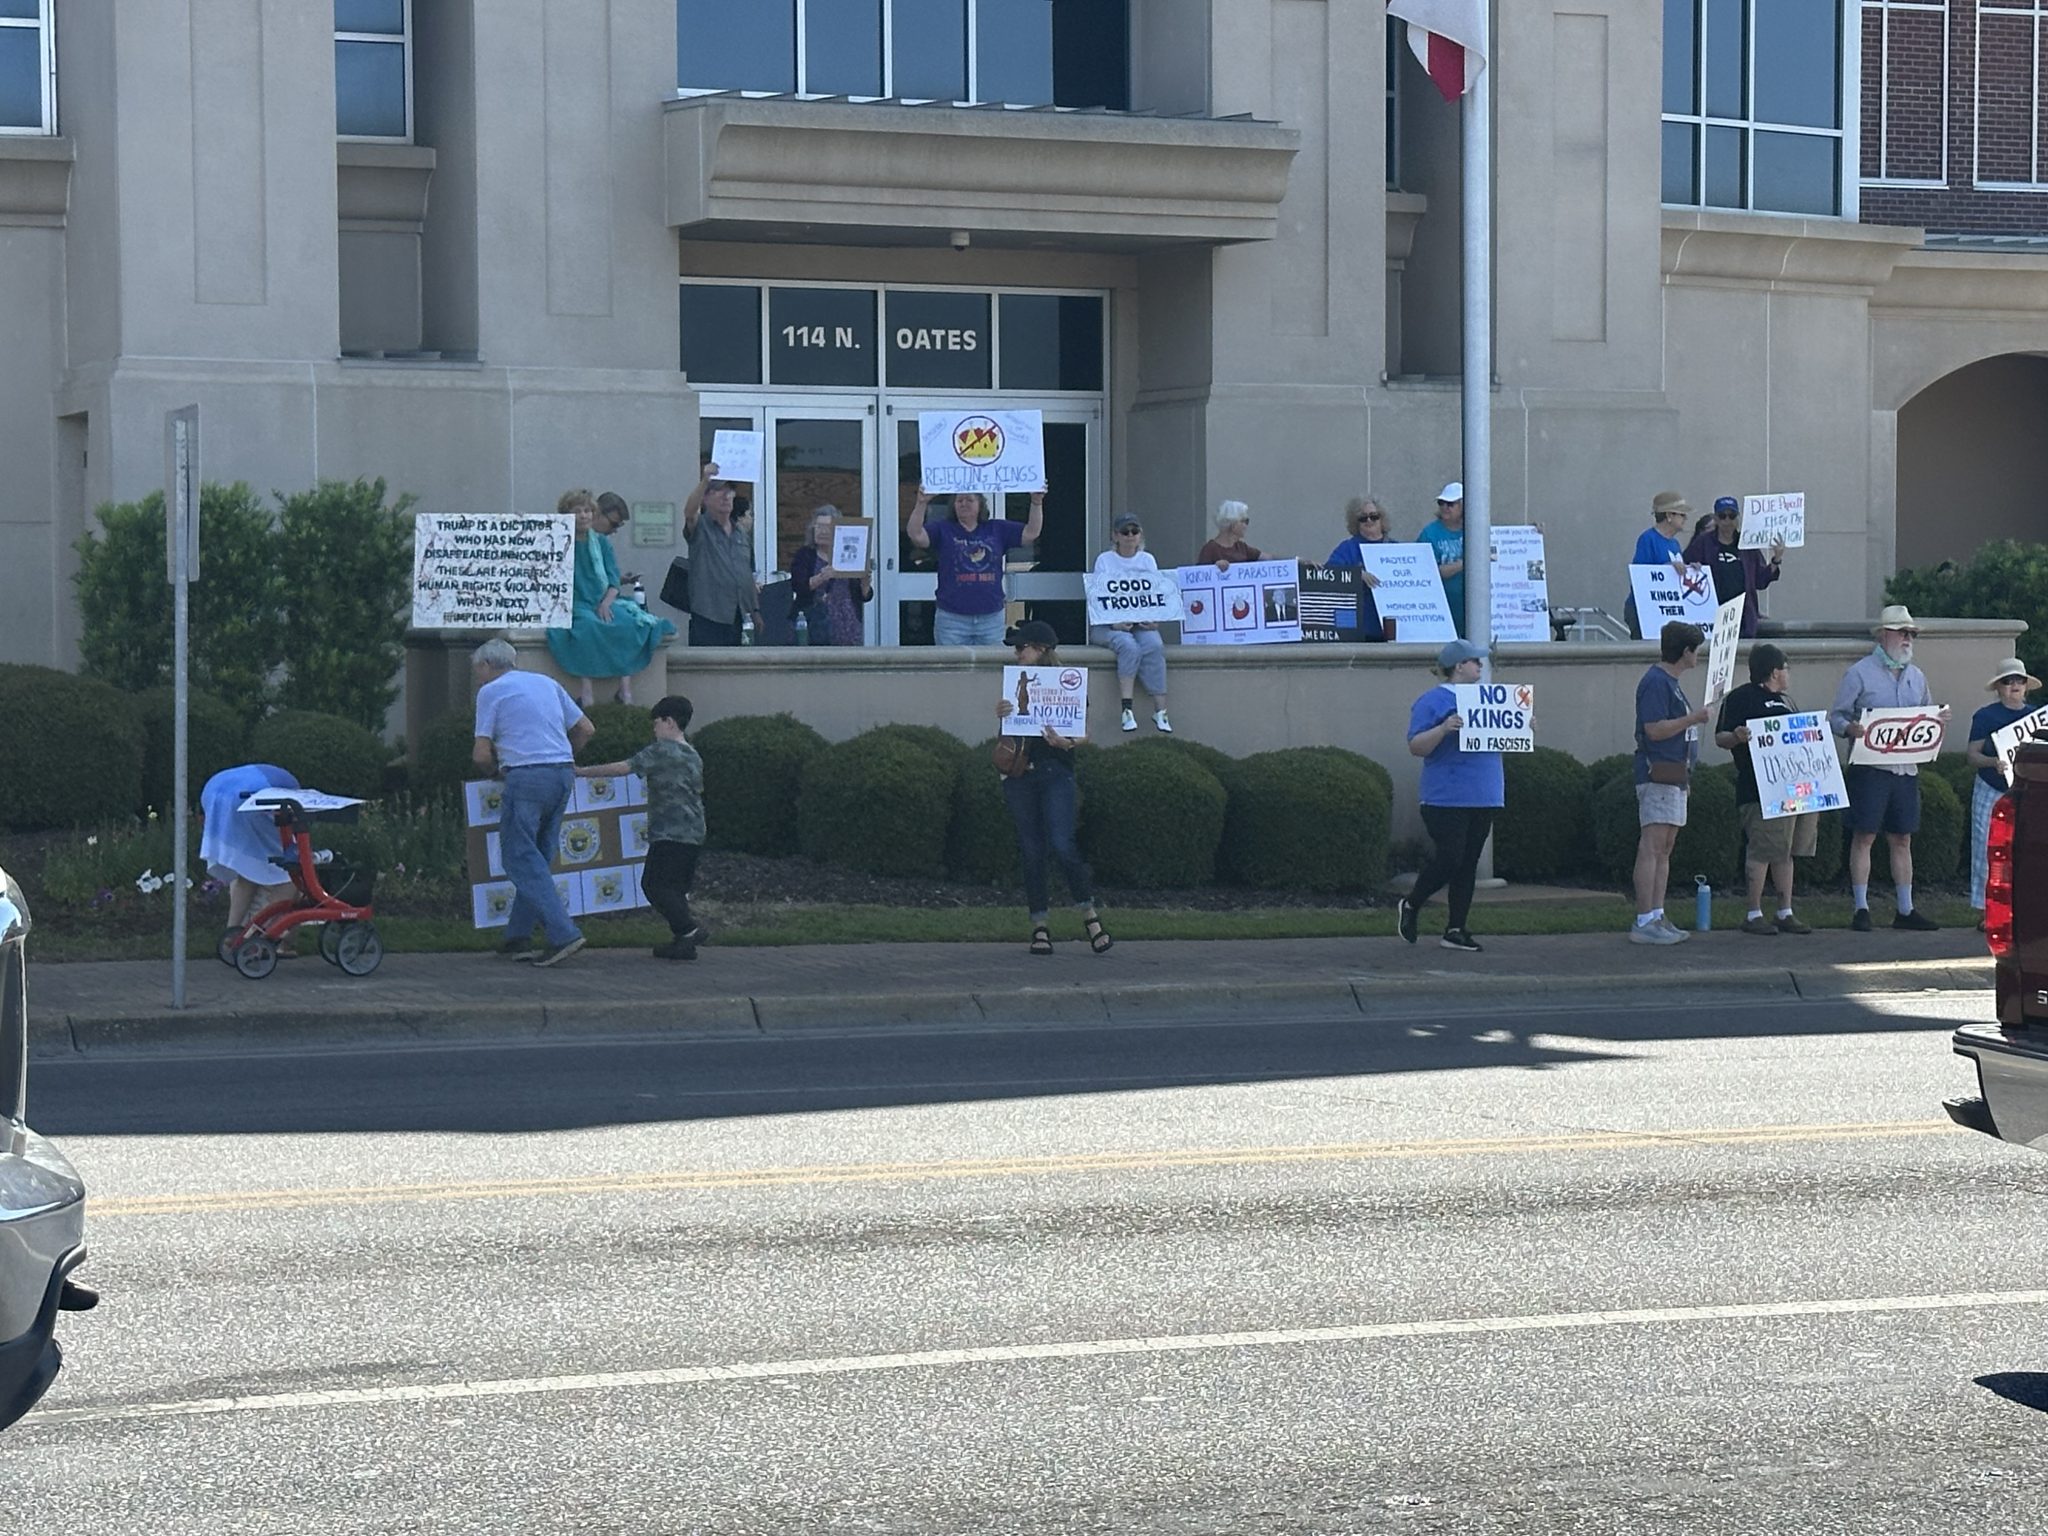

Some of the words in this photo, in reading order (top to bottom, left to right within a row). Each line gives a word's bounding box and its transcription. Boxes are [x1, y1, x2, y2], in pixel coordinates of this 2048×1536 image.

[782, 326, 826, 348] 114
[835, 327, 861, 349] N.
[896, 328, 977, 350] OATES
[925, 466, 988, 486] REJECTING
[995, 465, 1038, 482] KINGS
[1751, 498, 1776, 515] DUE
[437, 520, 476, 531] TRUMP
[477, 520, 487, 531] IS
[490, 521, 498, 531] A
[501, 520, 553, 531] DICTATOR
[454, 535, 481, 544] WHO
[484, 535, 506, 546] HAS
[508, 535, 536, 545] NOW
[424, 551, 498, 561] DISAPPEARED
[500, 551, 564, 561] INNOCENTS
[1380, 556, 1417, 564] PROTECT
[476, 567, 496, 577] ARE
[1185, 569, 1212, 584] KNOW
[1238, 565, 1289, 579] PARASITES
[1306, 569, 1335, 582] KINGS
[1341, 571, 1352, 583] IN
[1392, 569, 1412, 577] OUR
[1650, 570, 1665, 582] NO
[418, 581, 460, 591] HUMAN
[462, 582, 500, 592] RIGHTS
[505, 581, 568, 593] VIOLATIONS
[1107, 579, 1152, 593] GOOD
[1379, 580, 1432, 588] DEMOCRACY
[456, 597, 492, 607] WHO'S
[1097, 594, 1166, 610] TROUBLE
[1649, 590, 1680, 602] KINGS
[1419, 602, 1437, 610] OUR
[1659, 605, 1685, 616] THEN
[1722, 607, 1736, 625] NO
[1713, 624, 1738, 647] KING
[1712, 664, 1729, 685] USA
[1479, 685, 1507, 705] NO
[1034, 705, 1052, 717] NO
[1056, 705, 1083, 719] ONE
[1468, 708, 1524, 729] KINGS
[1763, 719, 1781, 733] NO
[1788, 715, 1819, 729] KINGS
[1757, 735, 1774, 748] NO
[1782, 729, 1824, 744] CROWNS
[1875, 725, 1936, 746] KINGS
[1466, 738, 1480, 750] NO
[1487, 737, 1531, 751] FASCISTS
